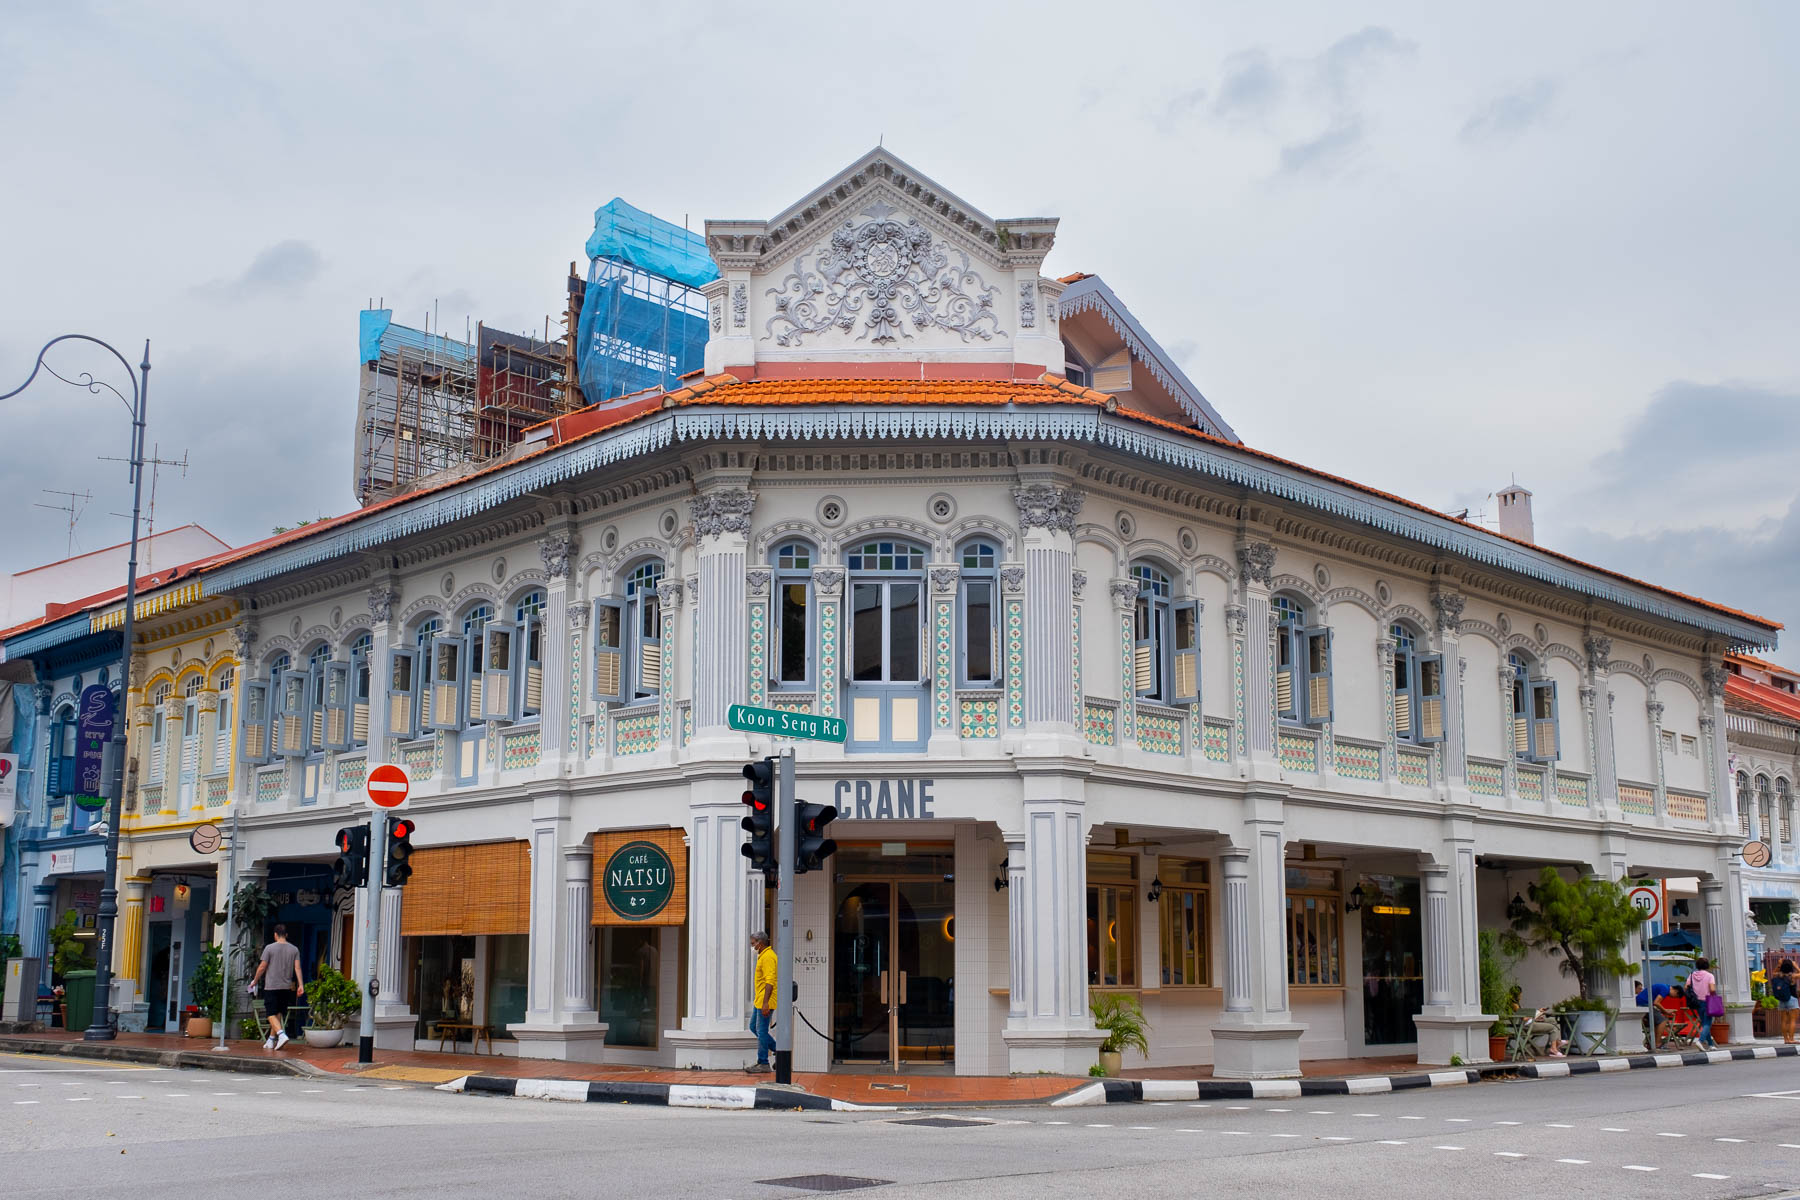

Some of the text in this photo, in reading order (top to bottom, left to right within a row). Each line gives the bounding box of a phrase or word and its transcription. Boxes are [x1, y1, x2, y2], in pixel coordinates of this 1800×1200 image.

[737, 707, 840, 737] Koon Seng Rd
[834, 779, 935, 820] CRANE
[629, 853, 649, 865] CAFÉ
[611, 867, 667, 887] NATSU
[630, 896, 646, 907] なつ
[1636, 897, 1650, 910] 50
[794, 956, 827, 964] NATSU
